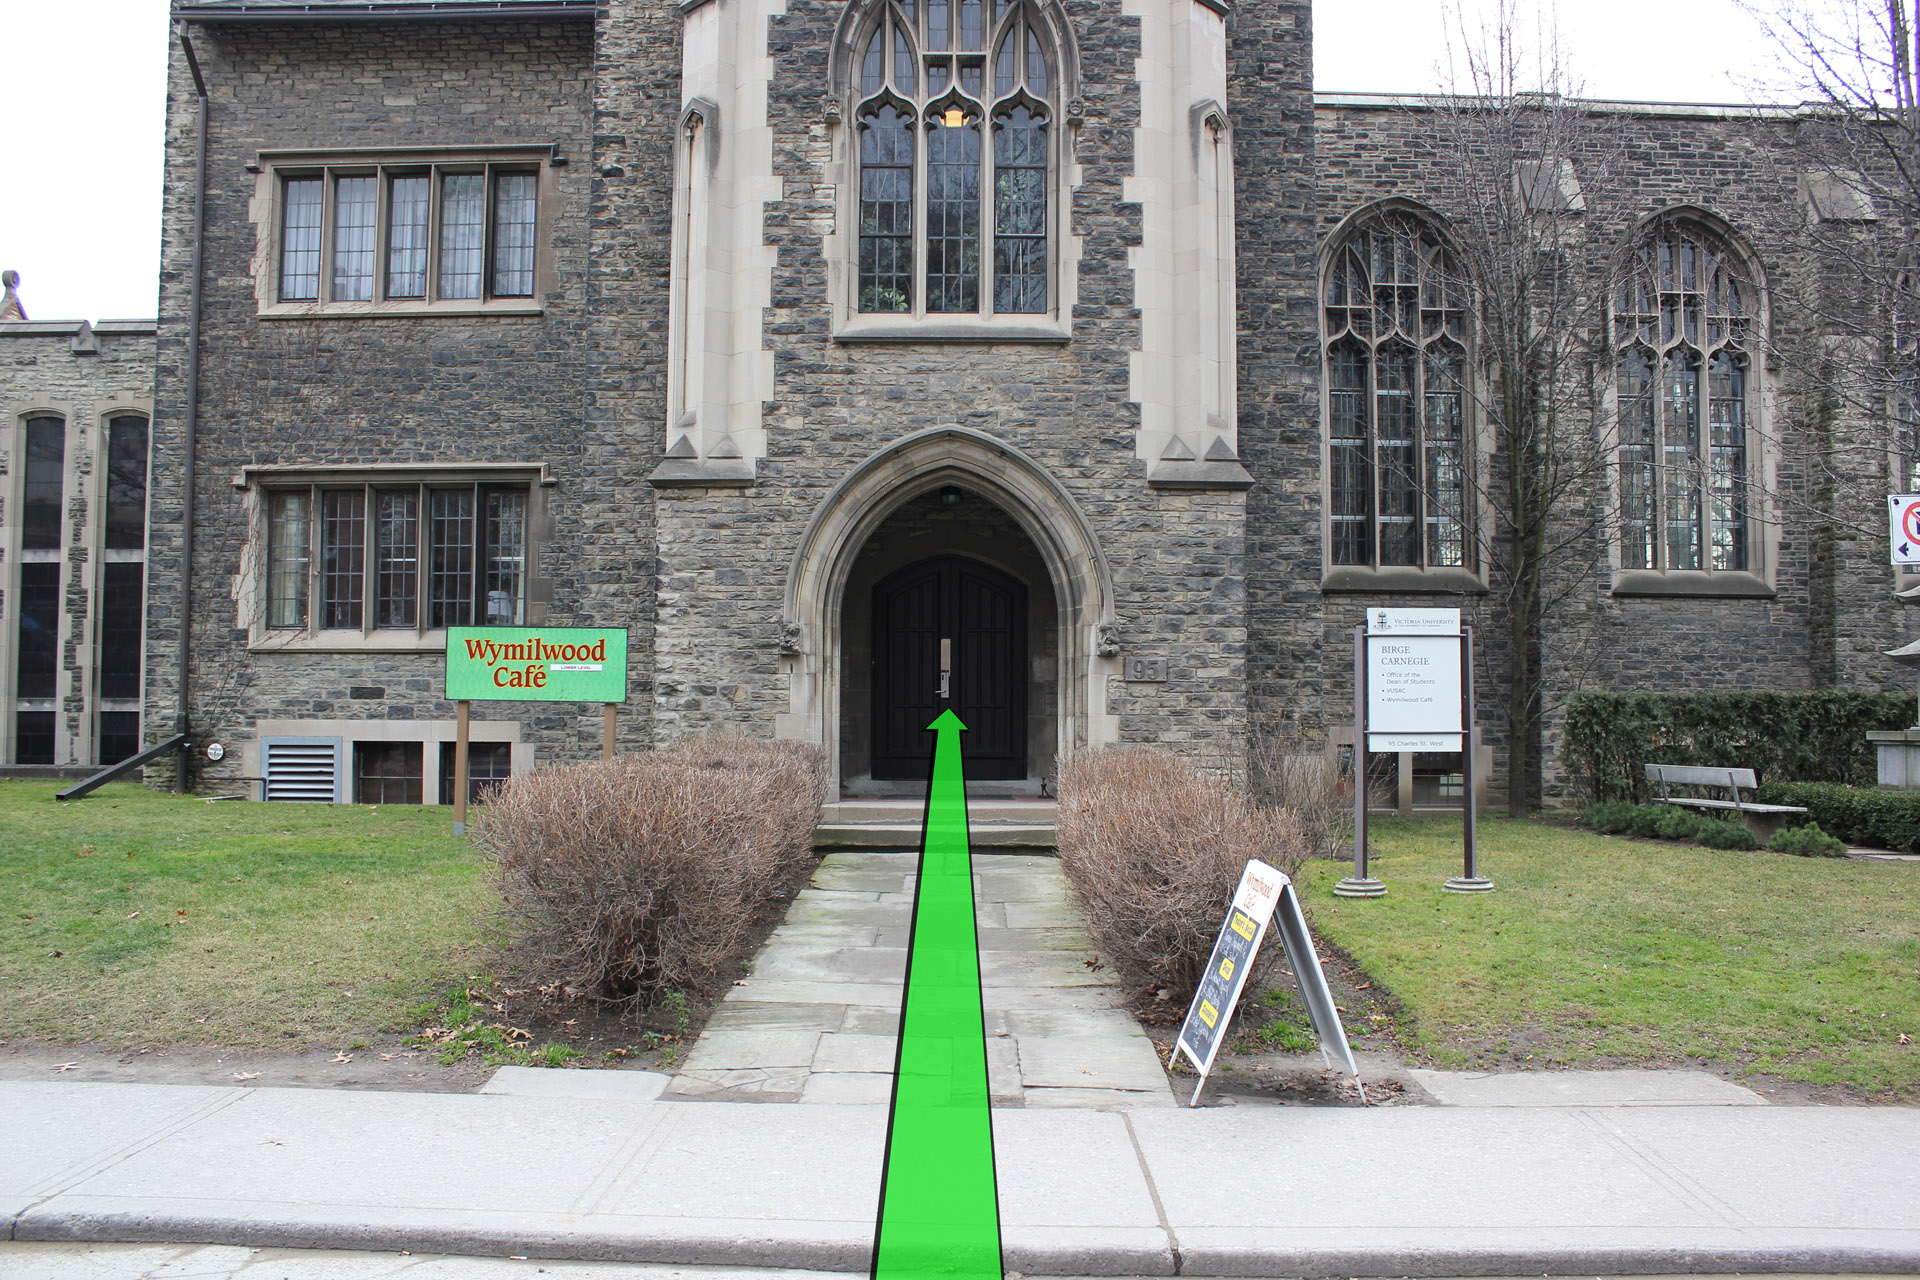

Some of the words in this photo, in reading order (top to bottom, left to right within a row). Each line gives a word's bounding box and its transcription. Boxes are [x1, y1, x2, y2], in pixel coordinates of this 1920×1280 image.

[464, 638, 606, 666] Wymilwood
[1381, 646, 1411, 654] BIRGE
[1133, 660, 1159, 680] 95
[1381, 657, 1430, 666] CARNEGIE
[493, 664, 547, 688] Café
